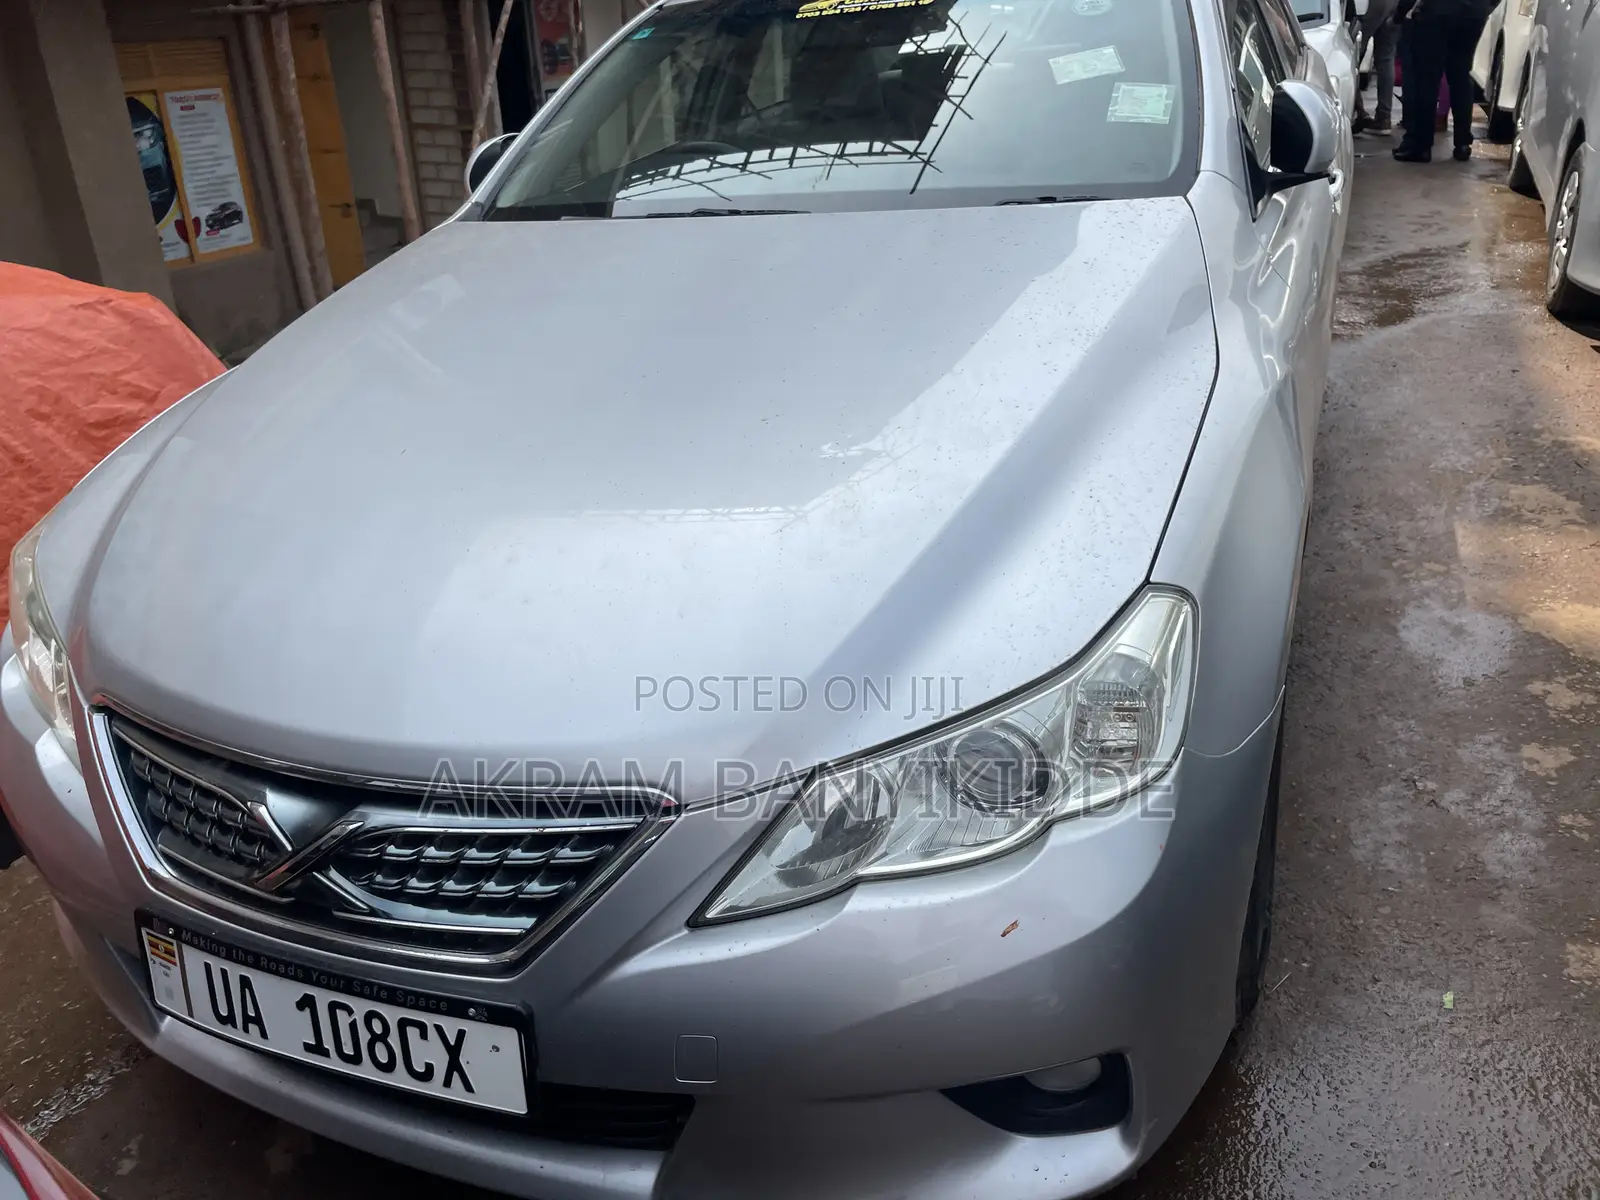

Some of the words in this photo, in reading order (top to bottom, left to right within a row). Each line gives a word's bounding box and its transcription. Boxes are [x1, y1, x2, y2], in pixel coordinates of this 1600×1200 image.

[181, 929, 228, 957] Making
[232, 948, 255, 964] the
[260, 956, 305, 979] Roads
[310, 969, 346, 989] Your
[352, 981, 388, 999] Safe
[396, 990, 449, 1011] Space
[203, 960, 270, 1040] UA
[295, 991, 477, 1094] 108CX
